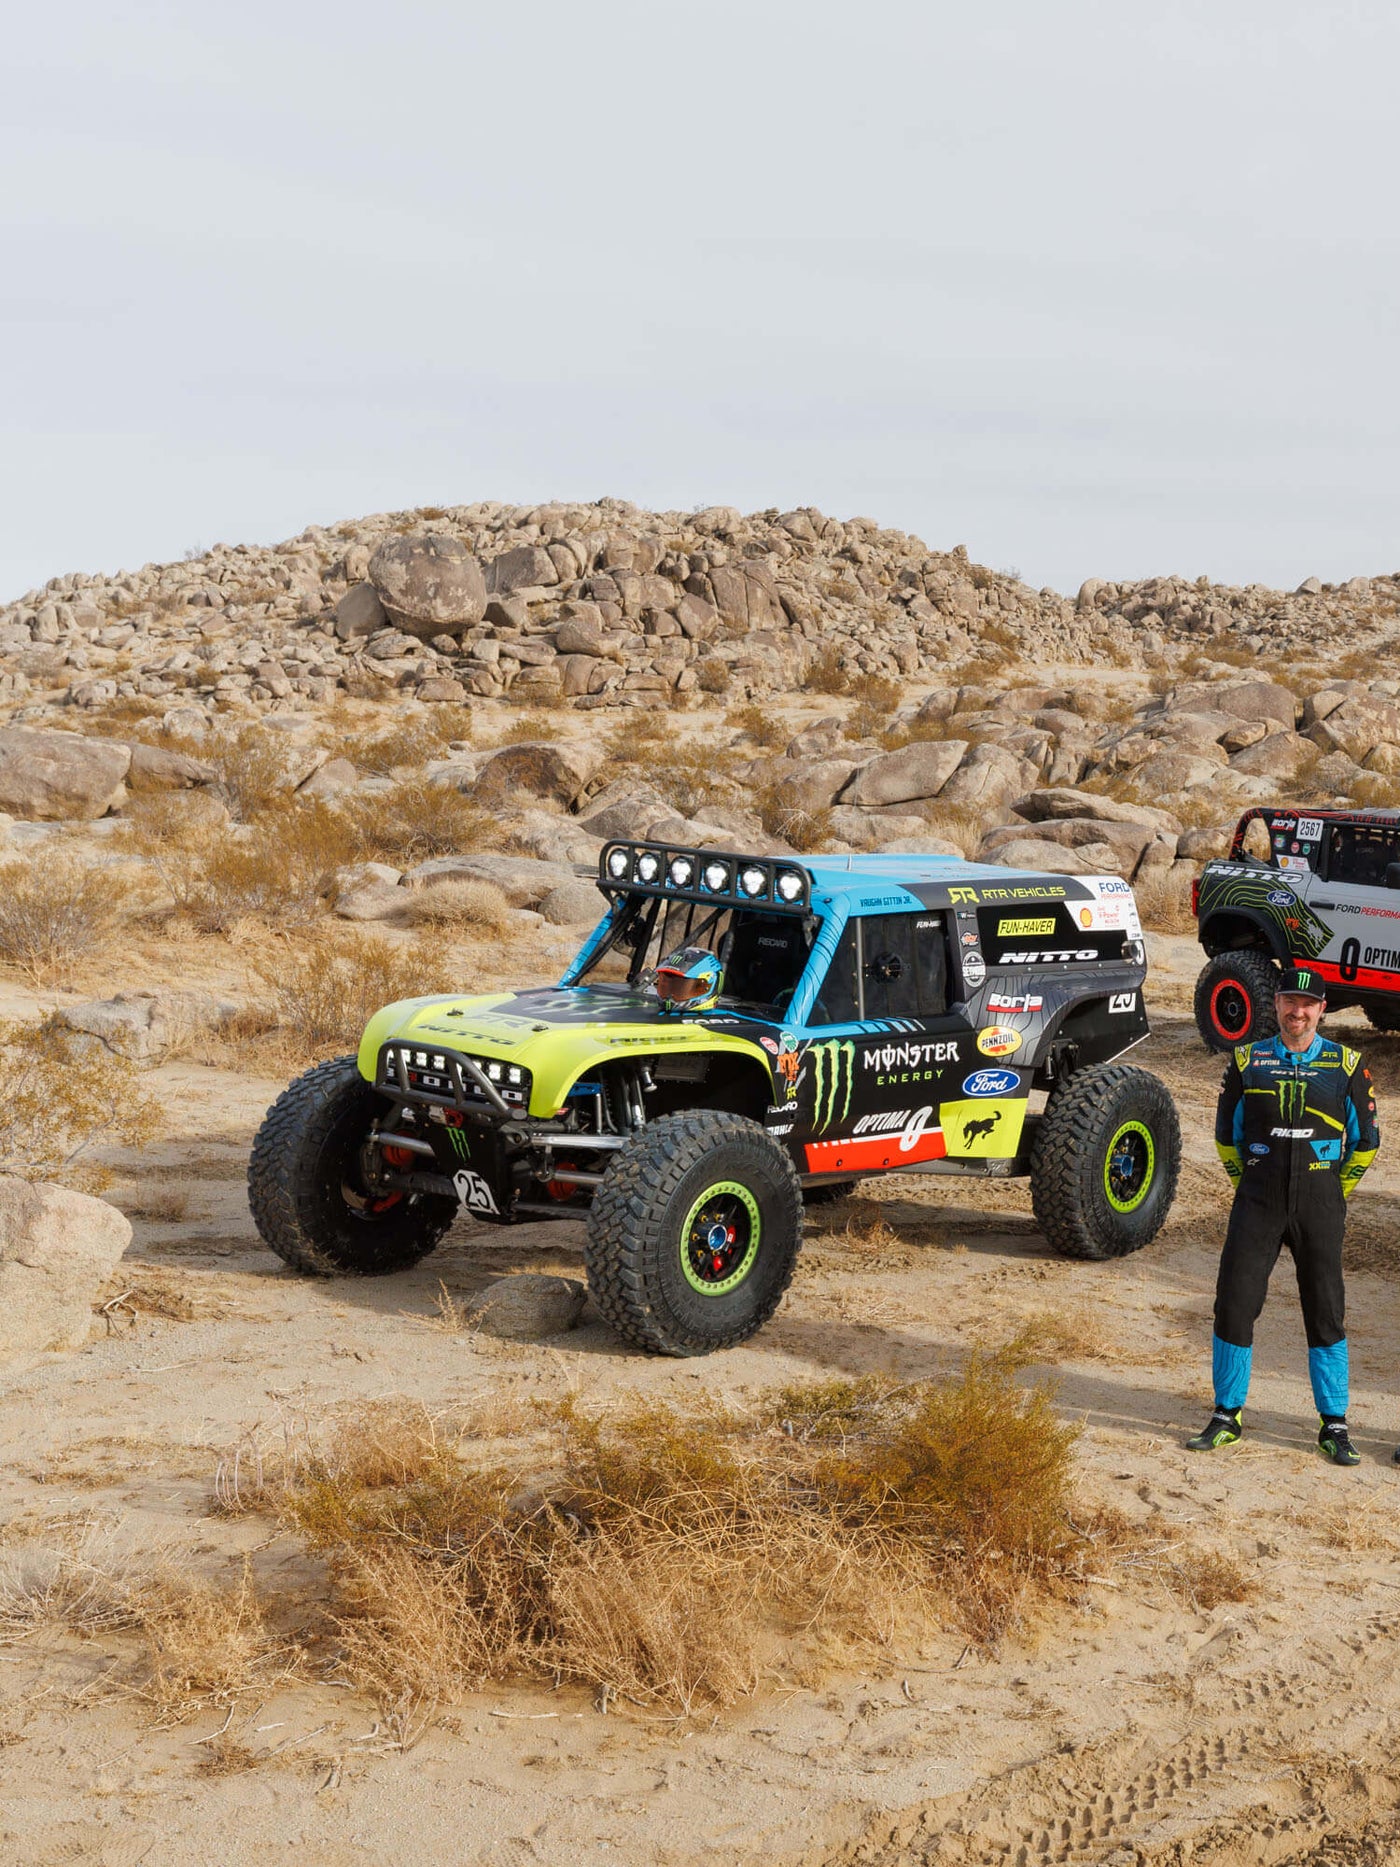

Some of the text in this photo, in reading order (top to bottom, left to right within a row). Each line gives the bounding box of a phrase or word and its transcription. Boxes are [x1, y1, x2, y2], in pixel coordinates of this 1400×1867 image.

[1300, 821, 1321, 837] 2567
[1206, 865, 1303, 883] NITTO
[982, 889, 1007, 900] RTR
[1009, 886, 1066, 897] VEHICLES
[1098, 882, 1131, 893] FORD
[883, 897, 902, 906] GITTIN
[1336, 904, 1361, 914] FORD
[1000, 919, 1053, 934] FUN-HAVER
[999, 949, 1099, 964] NITTO
[981, 1035, 1016, 1050] PENNZOIL
[863, 1041, 961, 1072] MONSTER
[876, 1069, 944, 1086] ENERGY
[970, 1073, 1008, 1092] Ford
[852, 1108, 912, 1135] OPTIMA
[457, 1172, 492, 1210] 25
